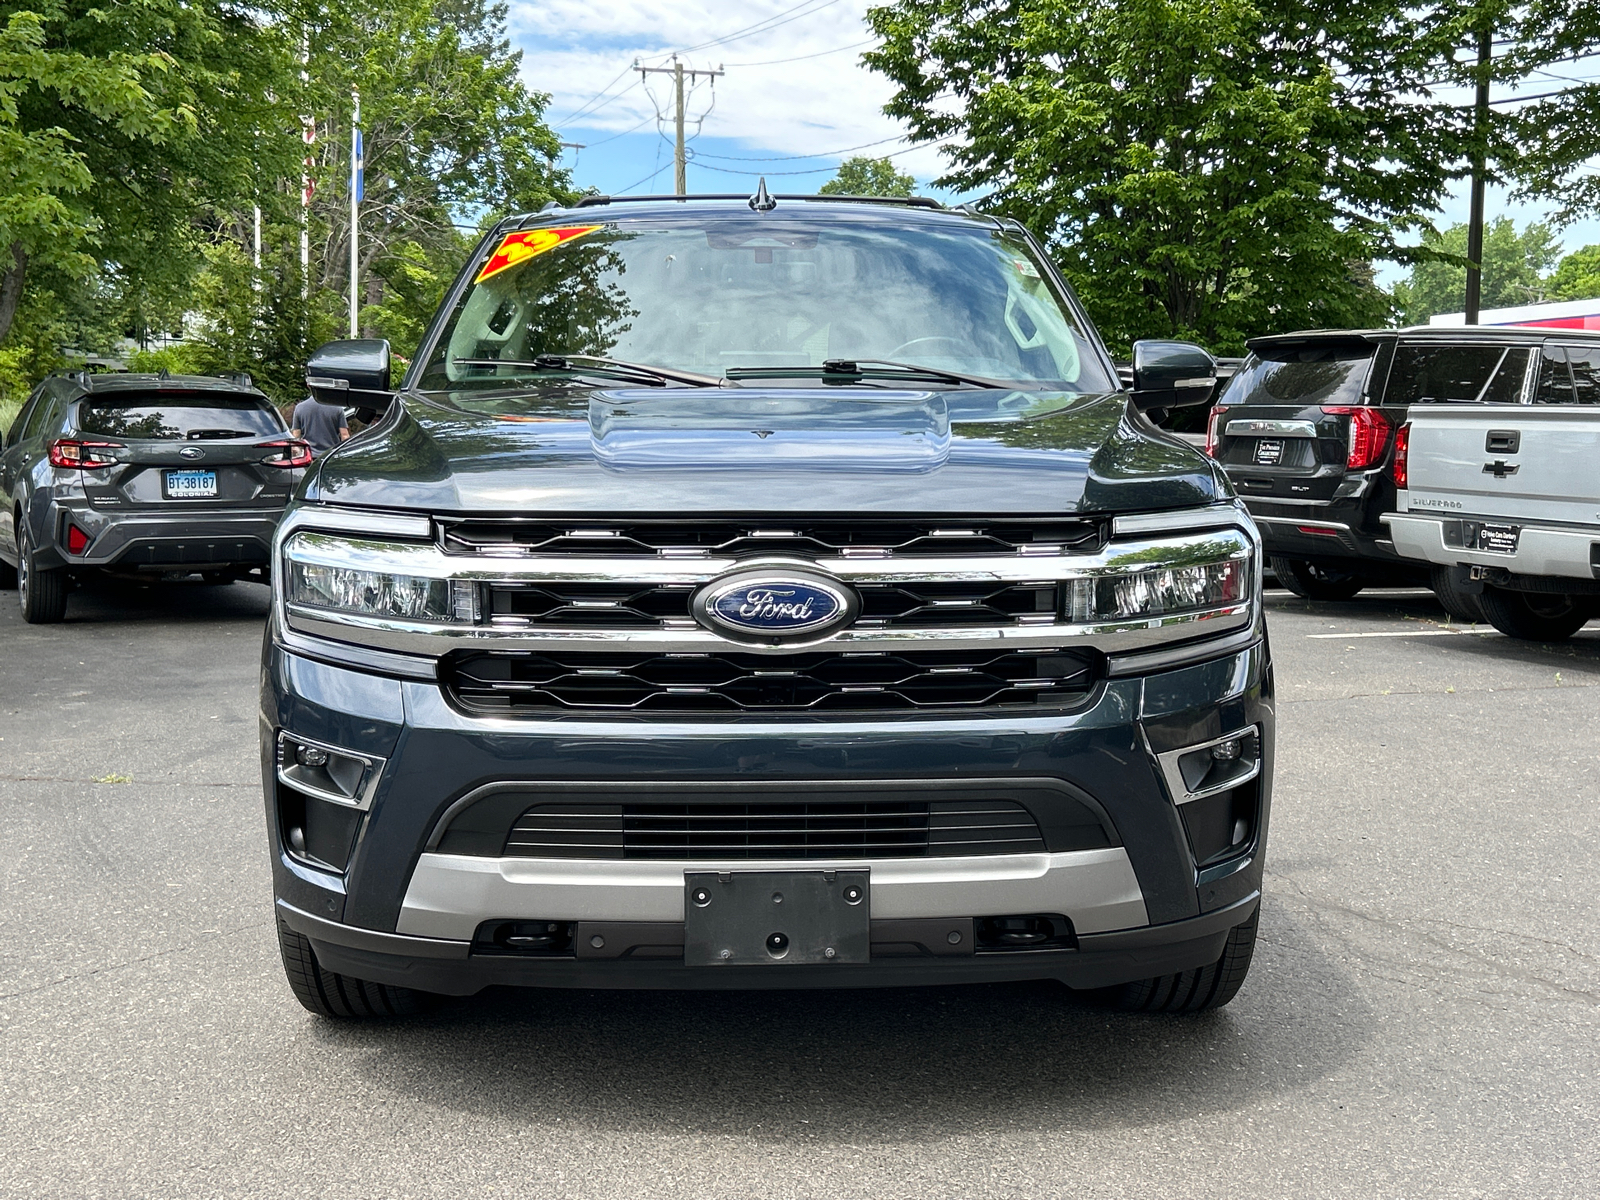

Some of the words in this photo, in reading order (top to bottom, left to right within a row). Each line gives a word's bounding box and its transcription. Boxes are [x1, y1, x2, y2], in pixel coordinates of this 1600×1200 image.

[497, 229, 560, 262] 23
[1413, 498, 1462, 508] SILVERADO
[740, 588, 814, 620] Ford
